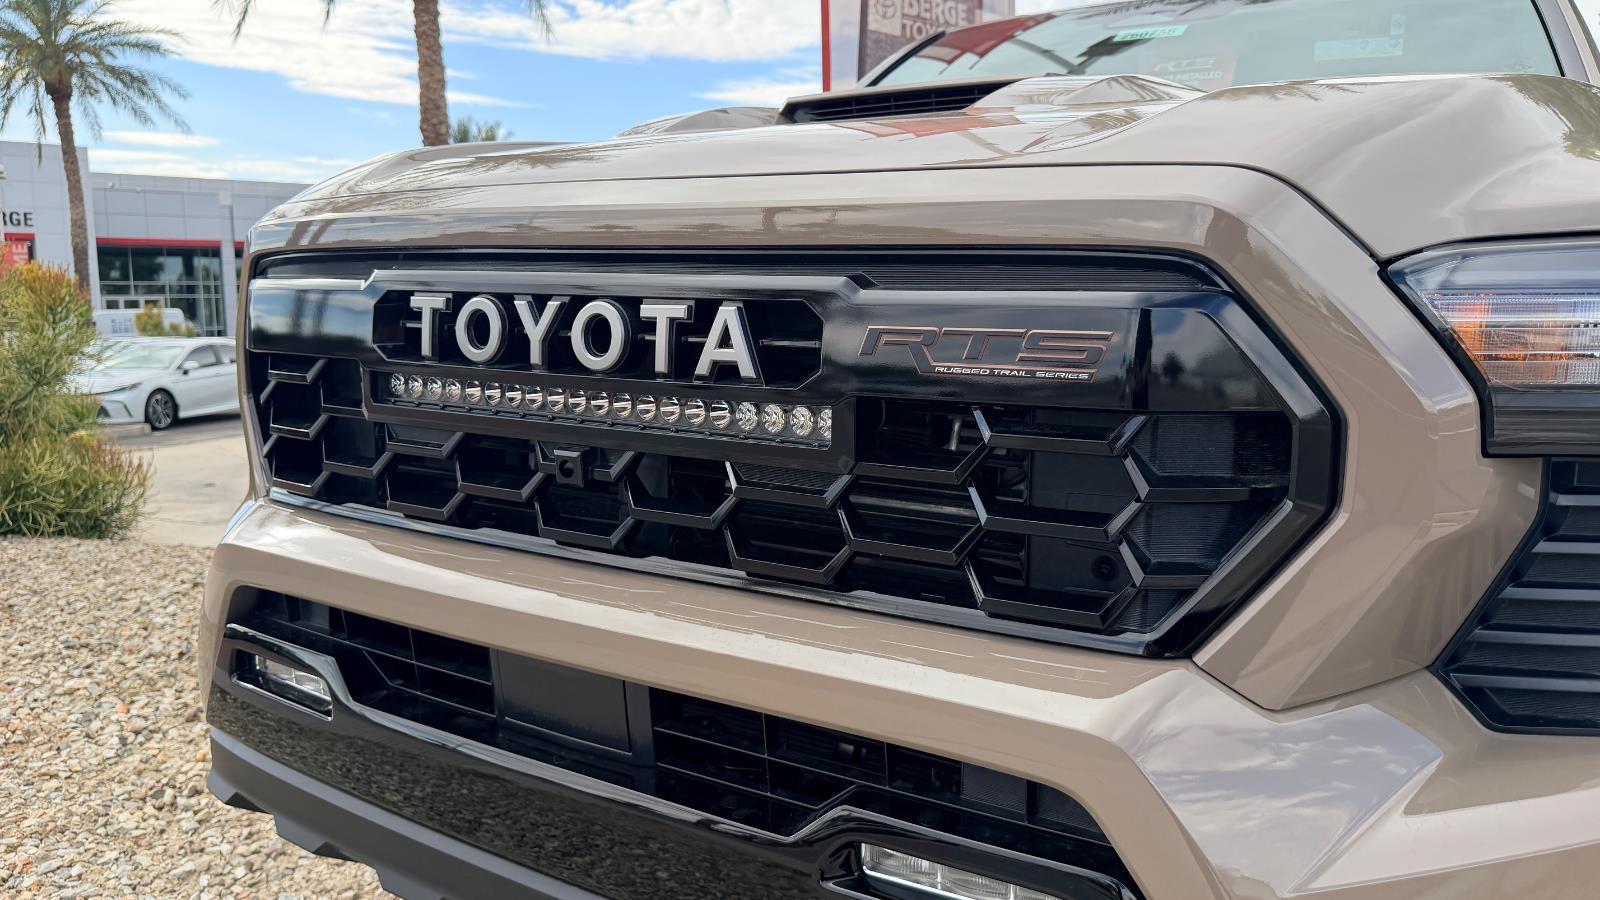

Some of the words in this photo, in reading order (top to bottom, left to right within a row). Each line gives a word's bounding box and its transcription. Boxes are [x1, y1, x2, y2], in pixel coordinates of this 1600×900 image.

[902, 20, 943, 40] TOY
[410, 294, 758, 379] TOYOTA
[858, 326, 1114, 374] RTS
[934, 366, 989, 375] RUGGED
[993, 369, 1031, 377] TRAIL
[1035, 371, 1089, 380] SERIES
